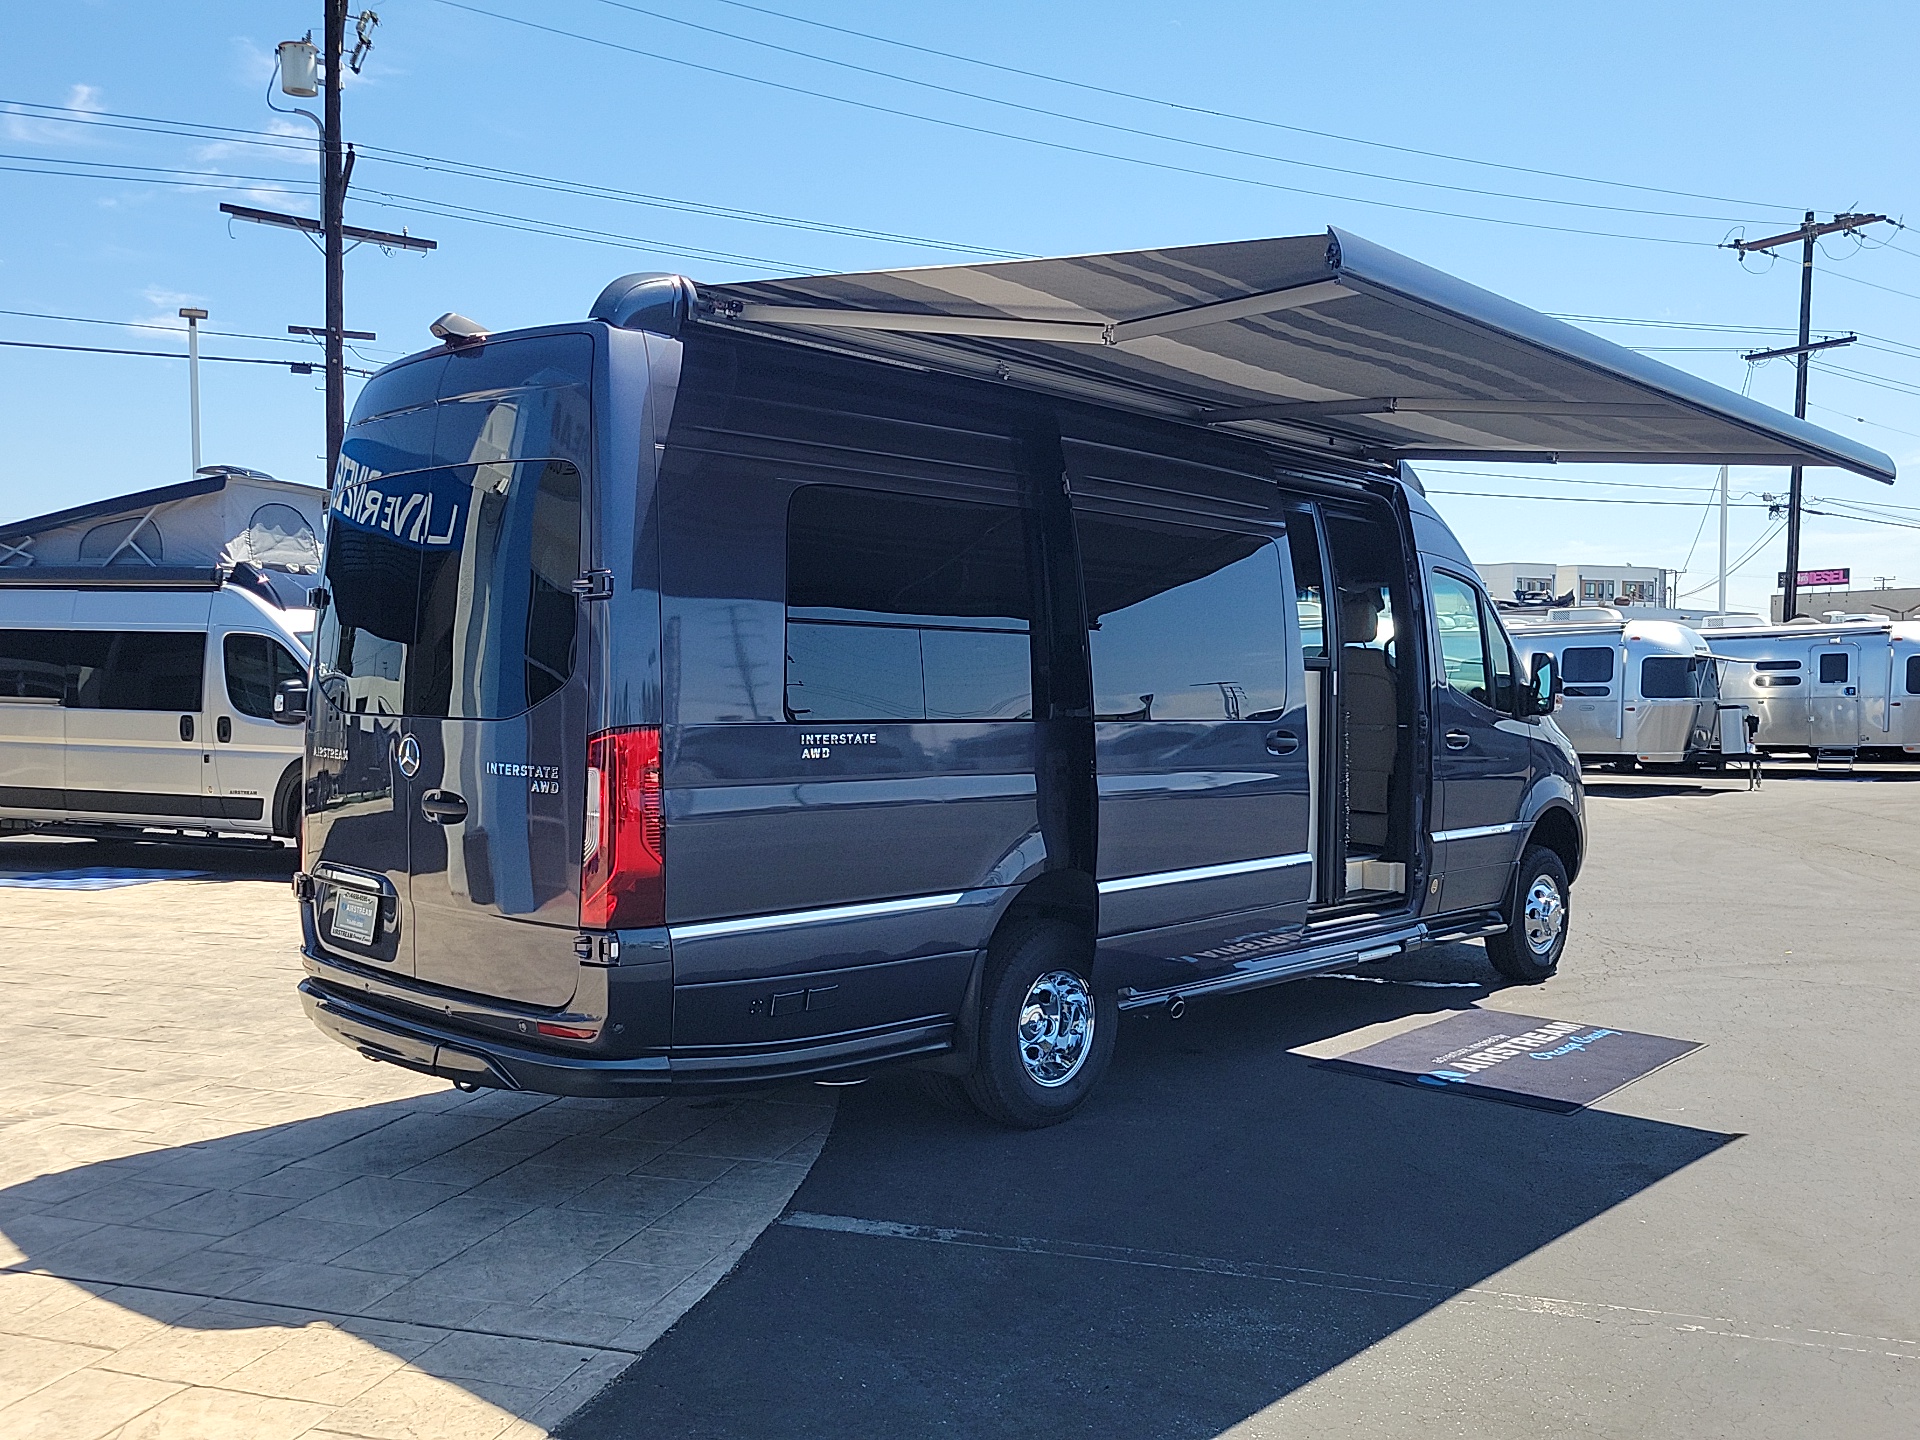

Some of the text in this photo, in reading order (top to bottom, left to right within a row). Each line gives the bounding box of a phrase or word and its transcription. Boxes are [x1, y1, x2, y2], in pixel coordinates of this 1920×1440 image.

[801, 733, 877, 745] INTERSTATE
[313, 746, 349, 761] AIRSTREAM
[801, 747, 830, 759] AWD
[486, 761, 560, 779] INTERSTATE
[530, 780, 560, 795] AWD
[1449, 1021, 1586, 1073] AIRSTREAM
